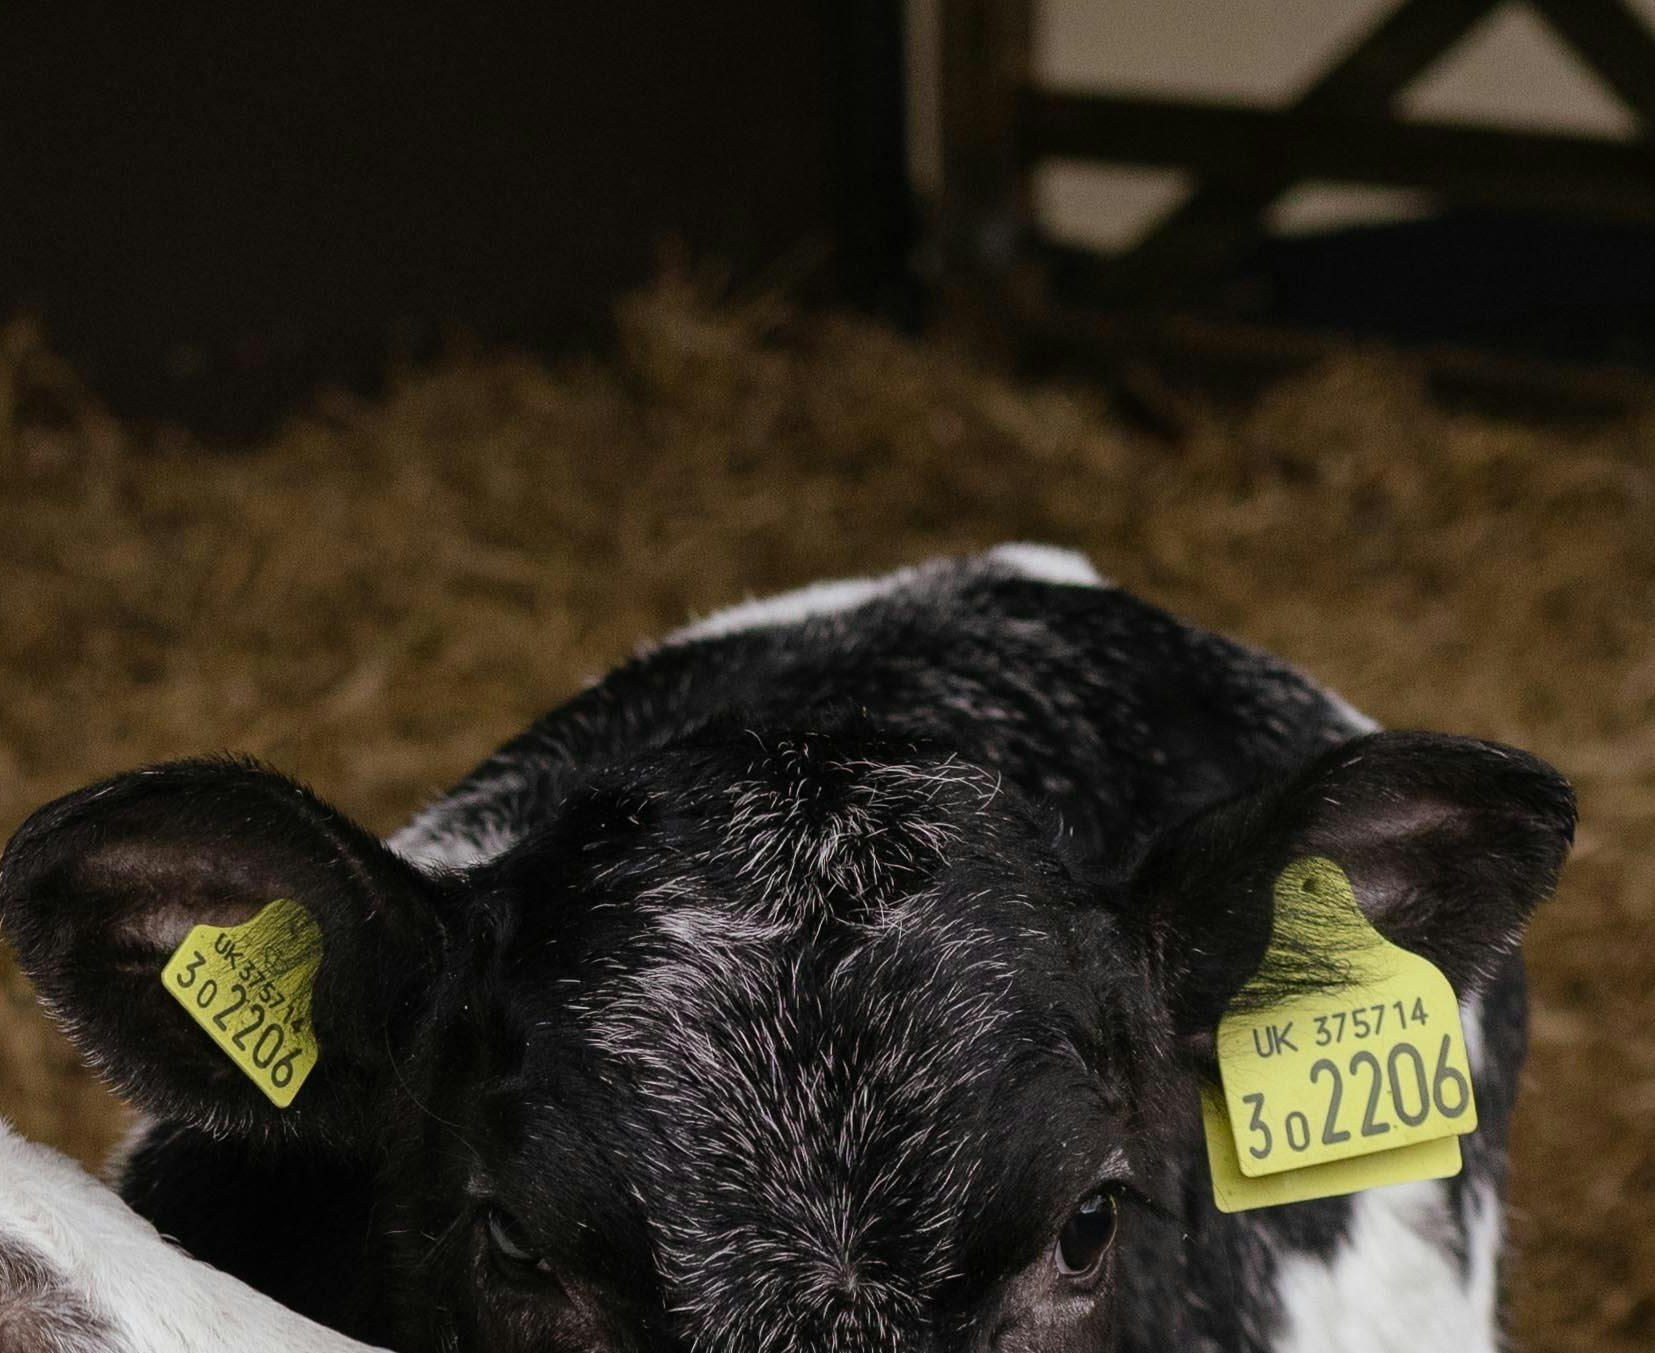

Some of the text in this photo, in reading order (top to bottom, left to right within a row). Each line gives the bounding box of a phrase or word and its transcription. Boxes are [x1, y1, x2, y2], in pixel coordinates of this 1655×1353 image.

[215, 933, 243, 970] UK
[1253, 997, 1429, 1058] UK 375714
